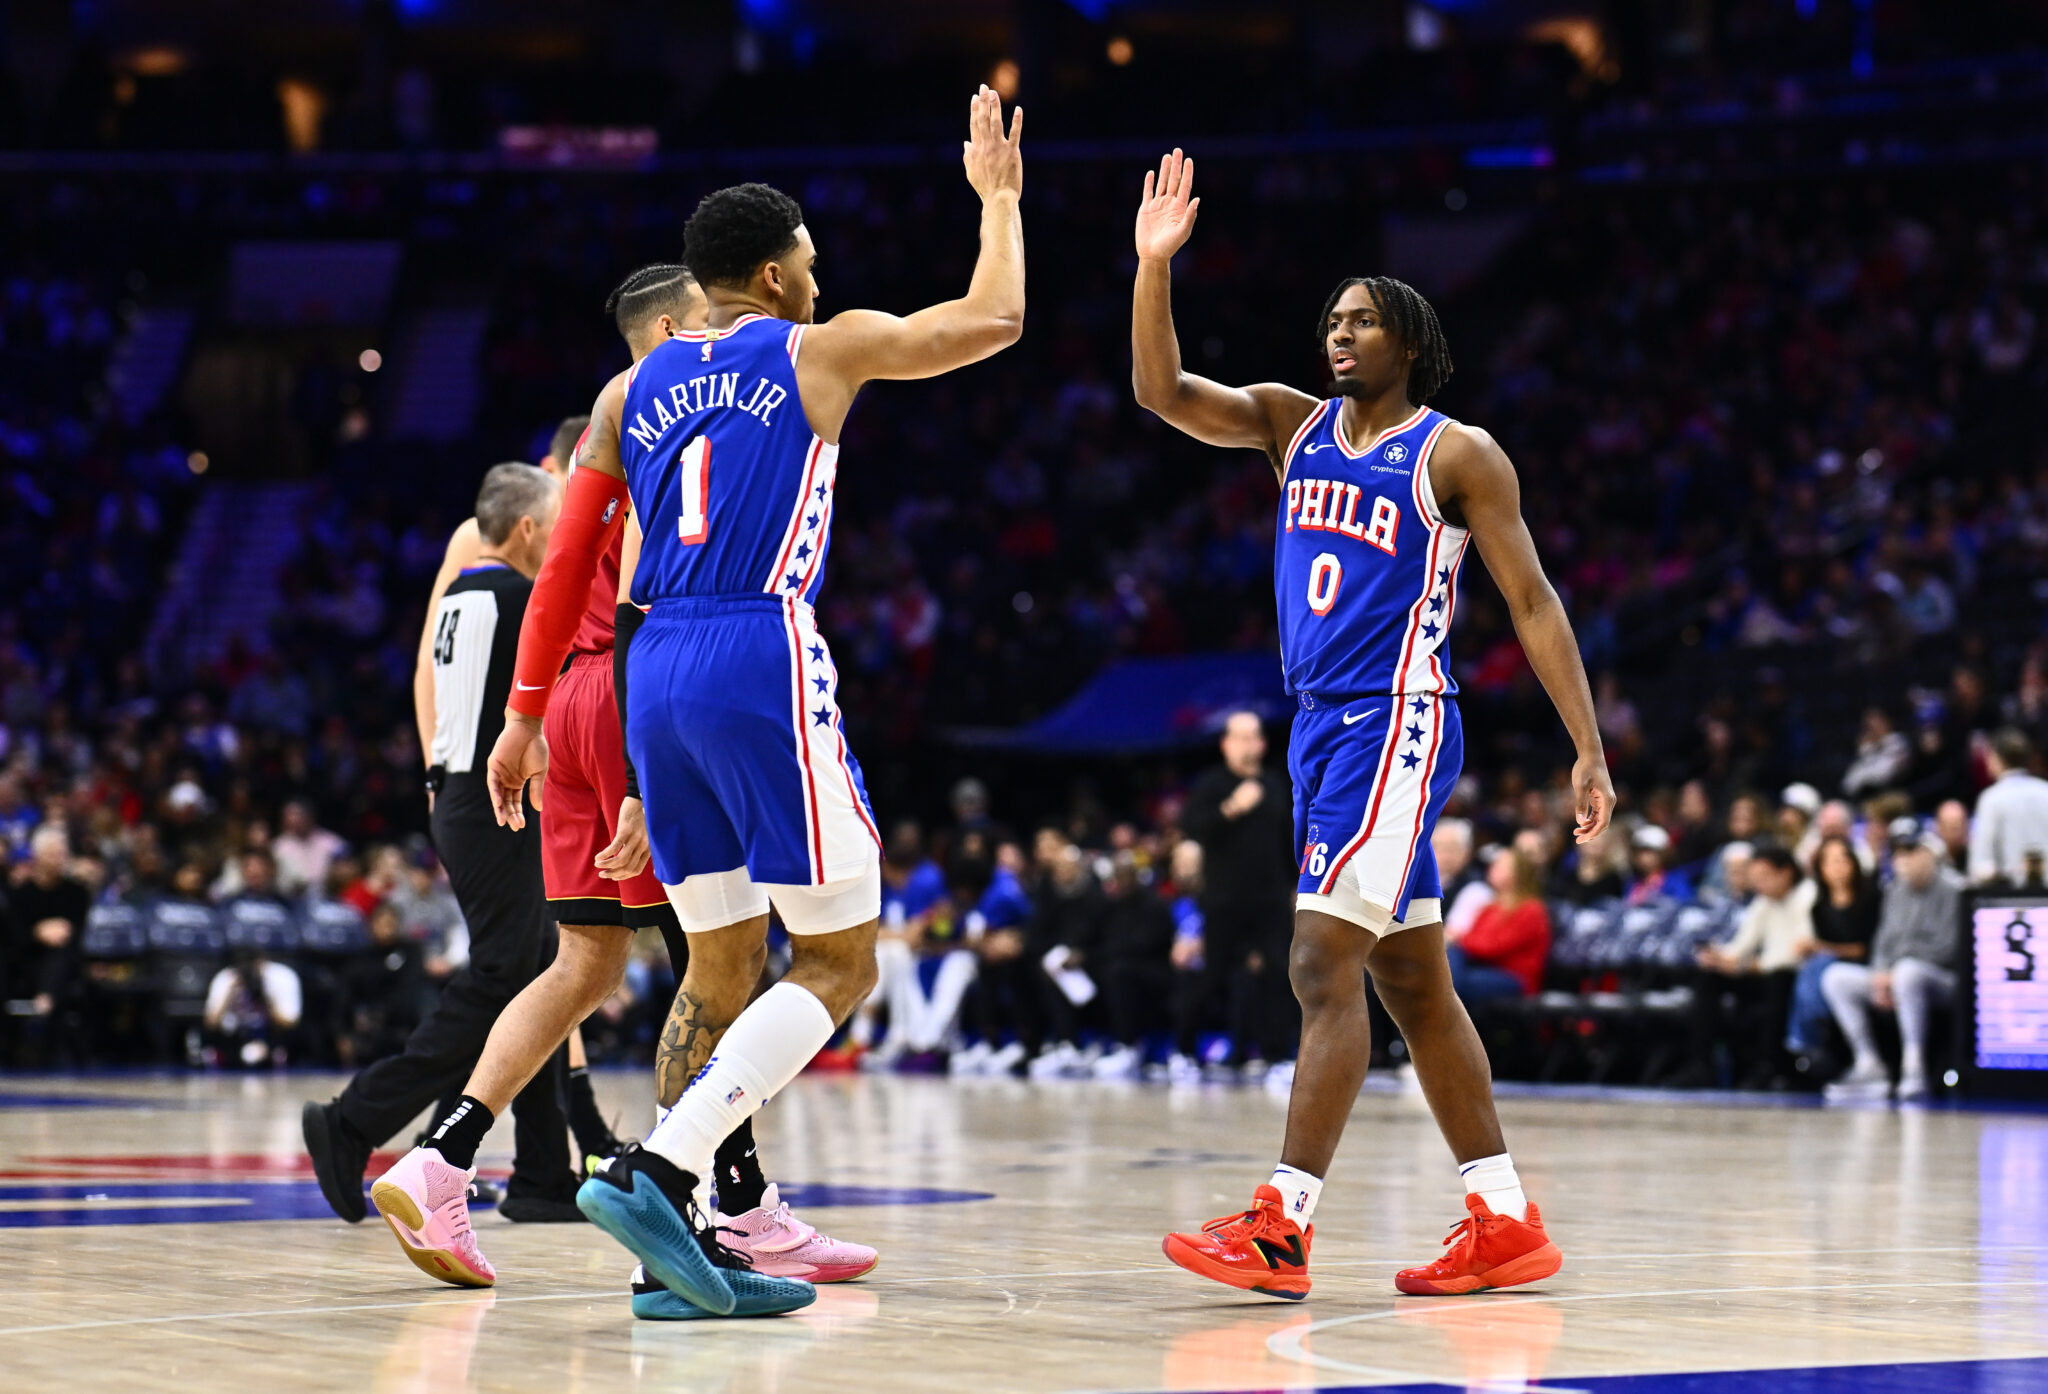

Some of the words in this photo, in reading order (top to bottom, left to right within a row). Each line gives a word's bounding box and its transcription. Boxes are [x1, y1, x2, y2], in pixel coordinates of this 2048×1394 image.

[628, 372, 740, 453] MARTIN
[737, 377, 787, 427] JR.
[678, 434, 712, 546] 1
[1370, 465, 1411, 477] crypto.com
[1285, 478, 1401, 557] PHILA
[1307, 552, 1343, 616] 0
[433, 608, 461, 666] 48
[1300, 842, 1329, 876] 76
